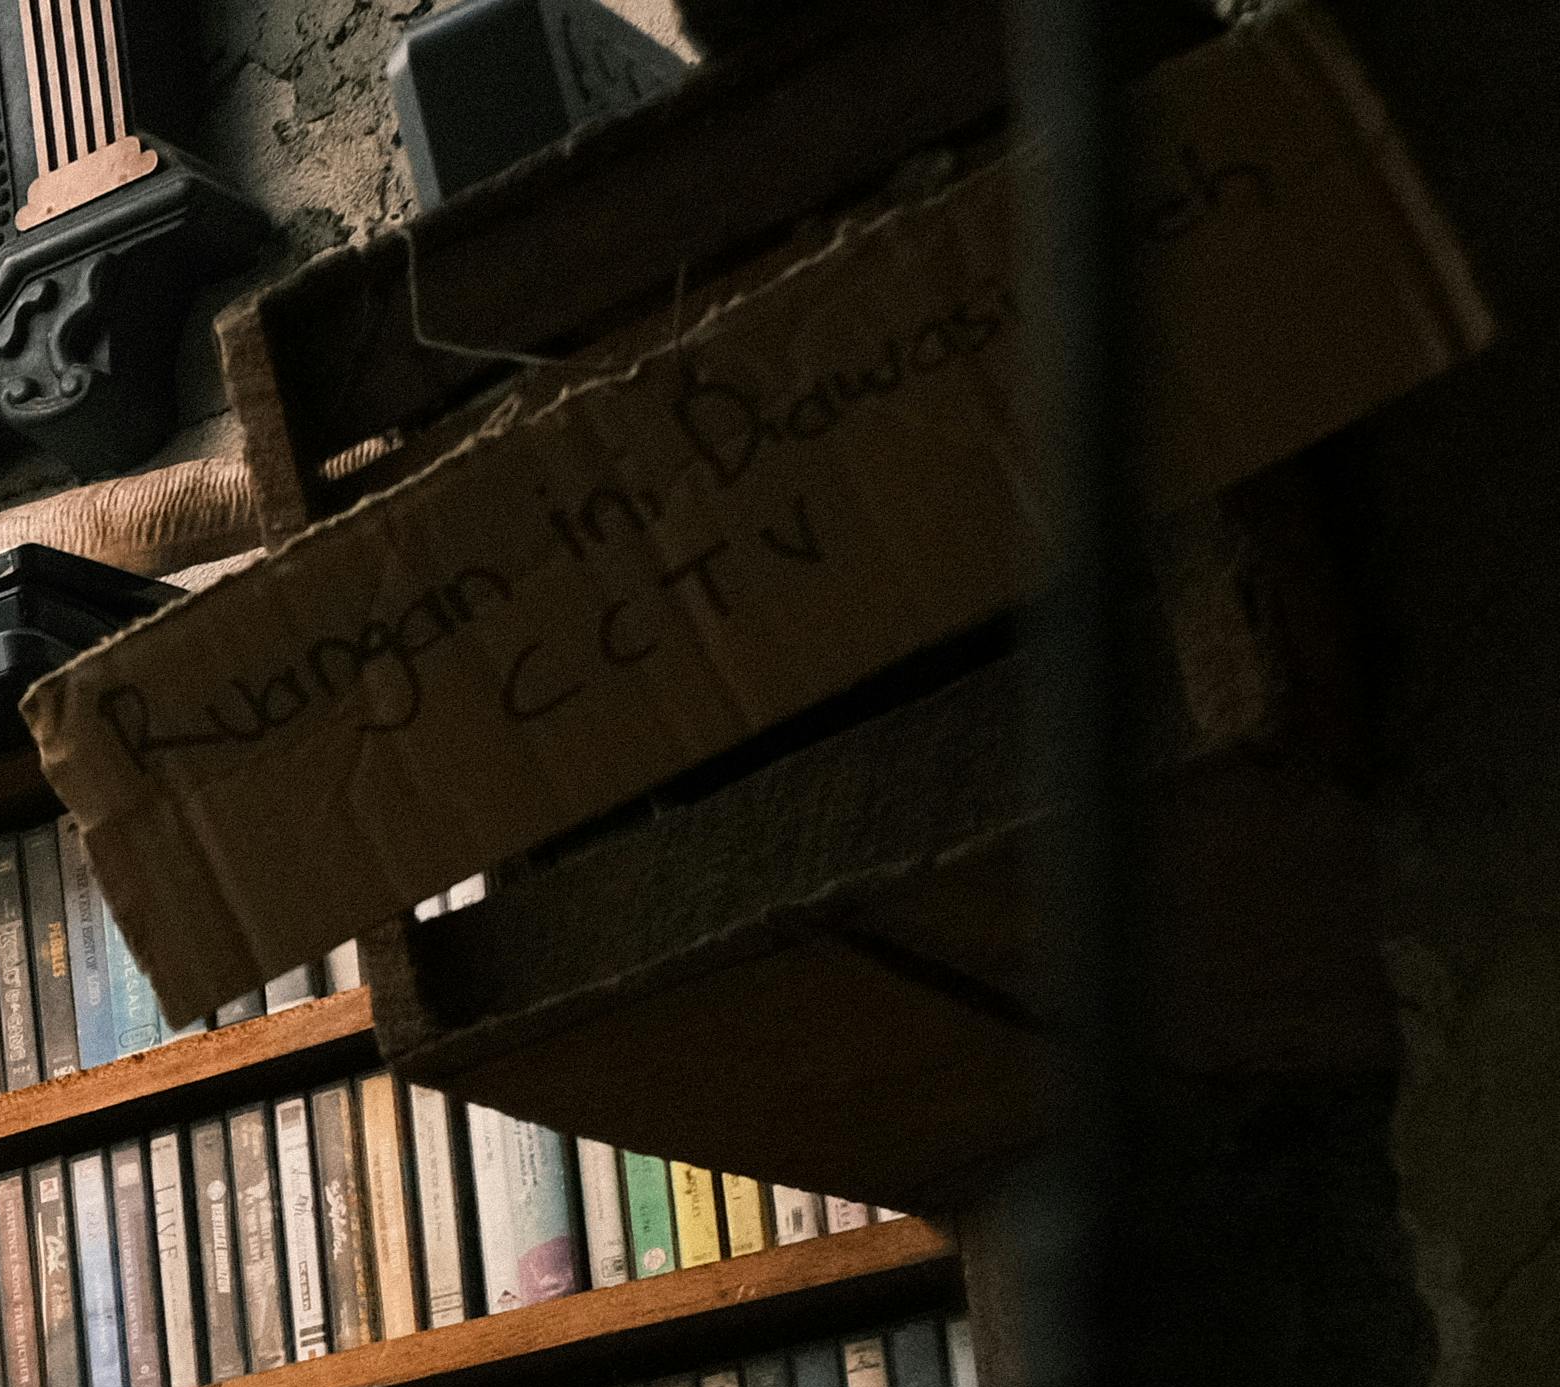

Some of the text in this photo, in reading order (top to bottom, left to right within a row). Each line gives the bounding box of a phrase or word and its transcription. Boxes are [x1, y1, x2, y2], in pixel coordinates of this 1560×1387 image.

[100, 563, 512, 775] Ruangan
[502, 497, 828, 725] CCTV
[48, 921, 65, 978] PEBBLES
[154, 1183, 178, 1264] LIVE
